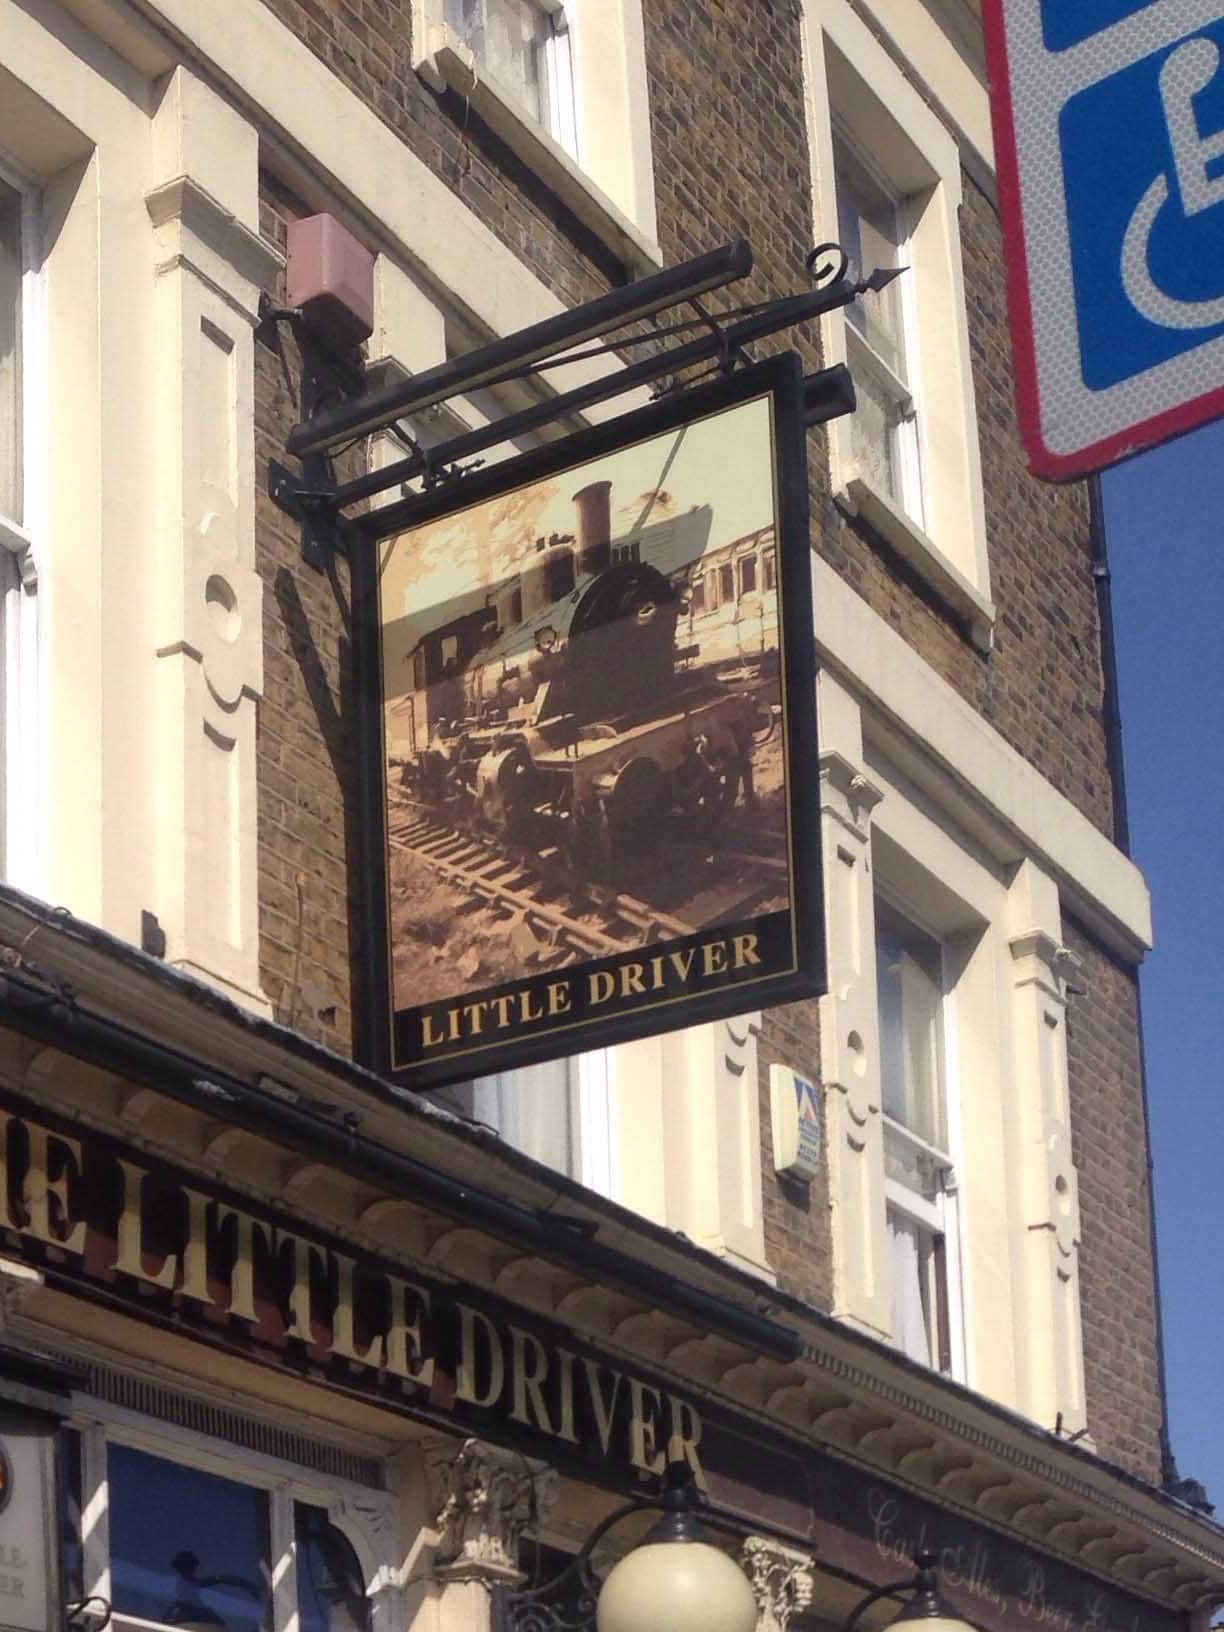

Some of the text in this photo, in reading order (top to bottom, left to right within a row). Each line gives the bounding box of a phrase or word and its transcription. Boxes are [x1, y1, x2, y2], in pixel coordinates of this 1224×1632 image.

[421, 932, 762, 1048] LITTLE DRIVER
[110, 1157, 435, 1387] LITTLE
[455, 1302, 708, 1503] DRIVER
